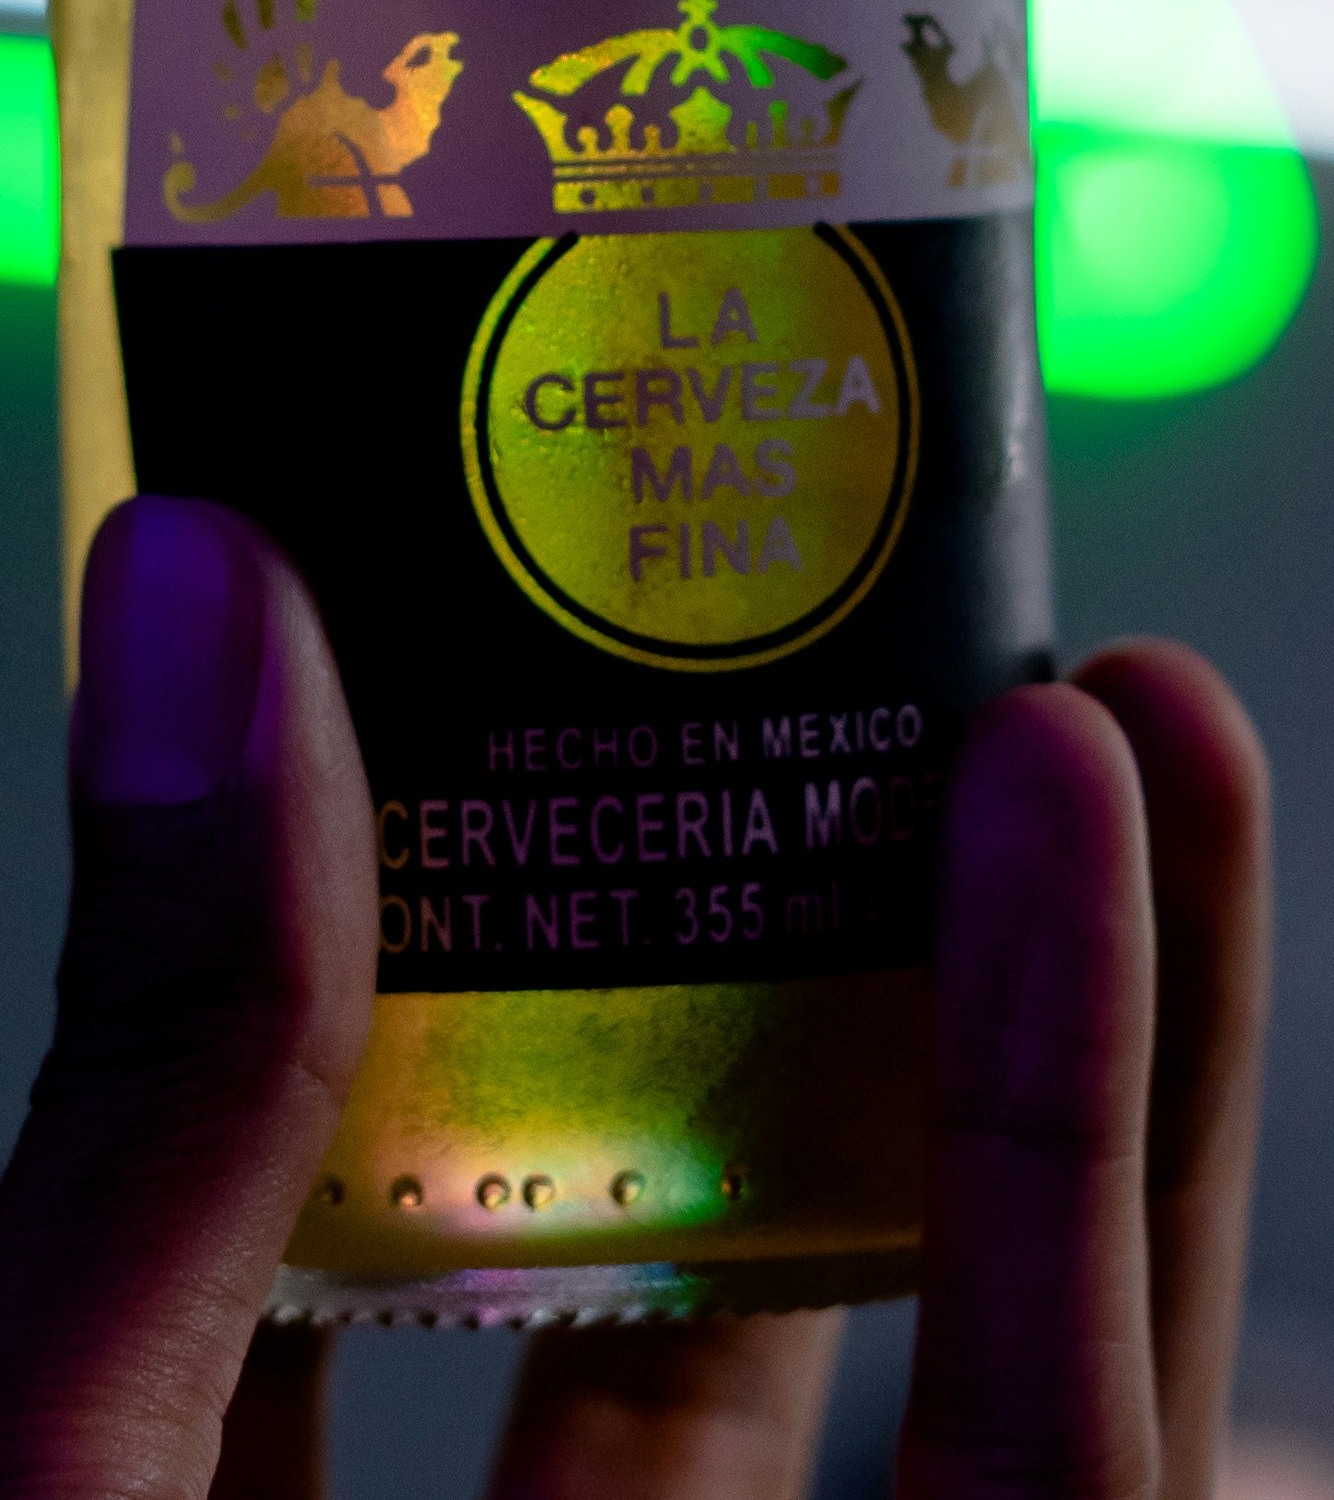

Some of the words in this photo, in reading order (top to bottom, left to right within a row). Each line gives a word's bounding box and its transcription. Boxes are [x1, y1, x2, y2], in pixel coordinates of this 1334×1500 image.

[658, 287, 760, 350] LA
[523, 354, 882, 432] CERVEZA
[631, 437, 797, 502] MAS
[629, 516, 805, 582] FINA
[486, 723, 659, 772] HECHO
[681, 719, 741, 767] EN
[760, 702, 925, 760] MEXICO
[377, 787, 779, 871] CERVECERIA
[379, 892, 504, 955] ONT.
[524, 887, 652, 952] NET.
[674, 881, 765, 946] 355
[784, 874, 842, 936] ml
